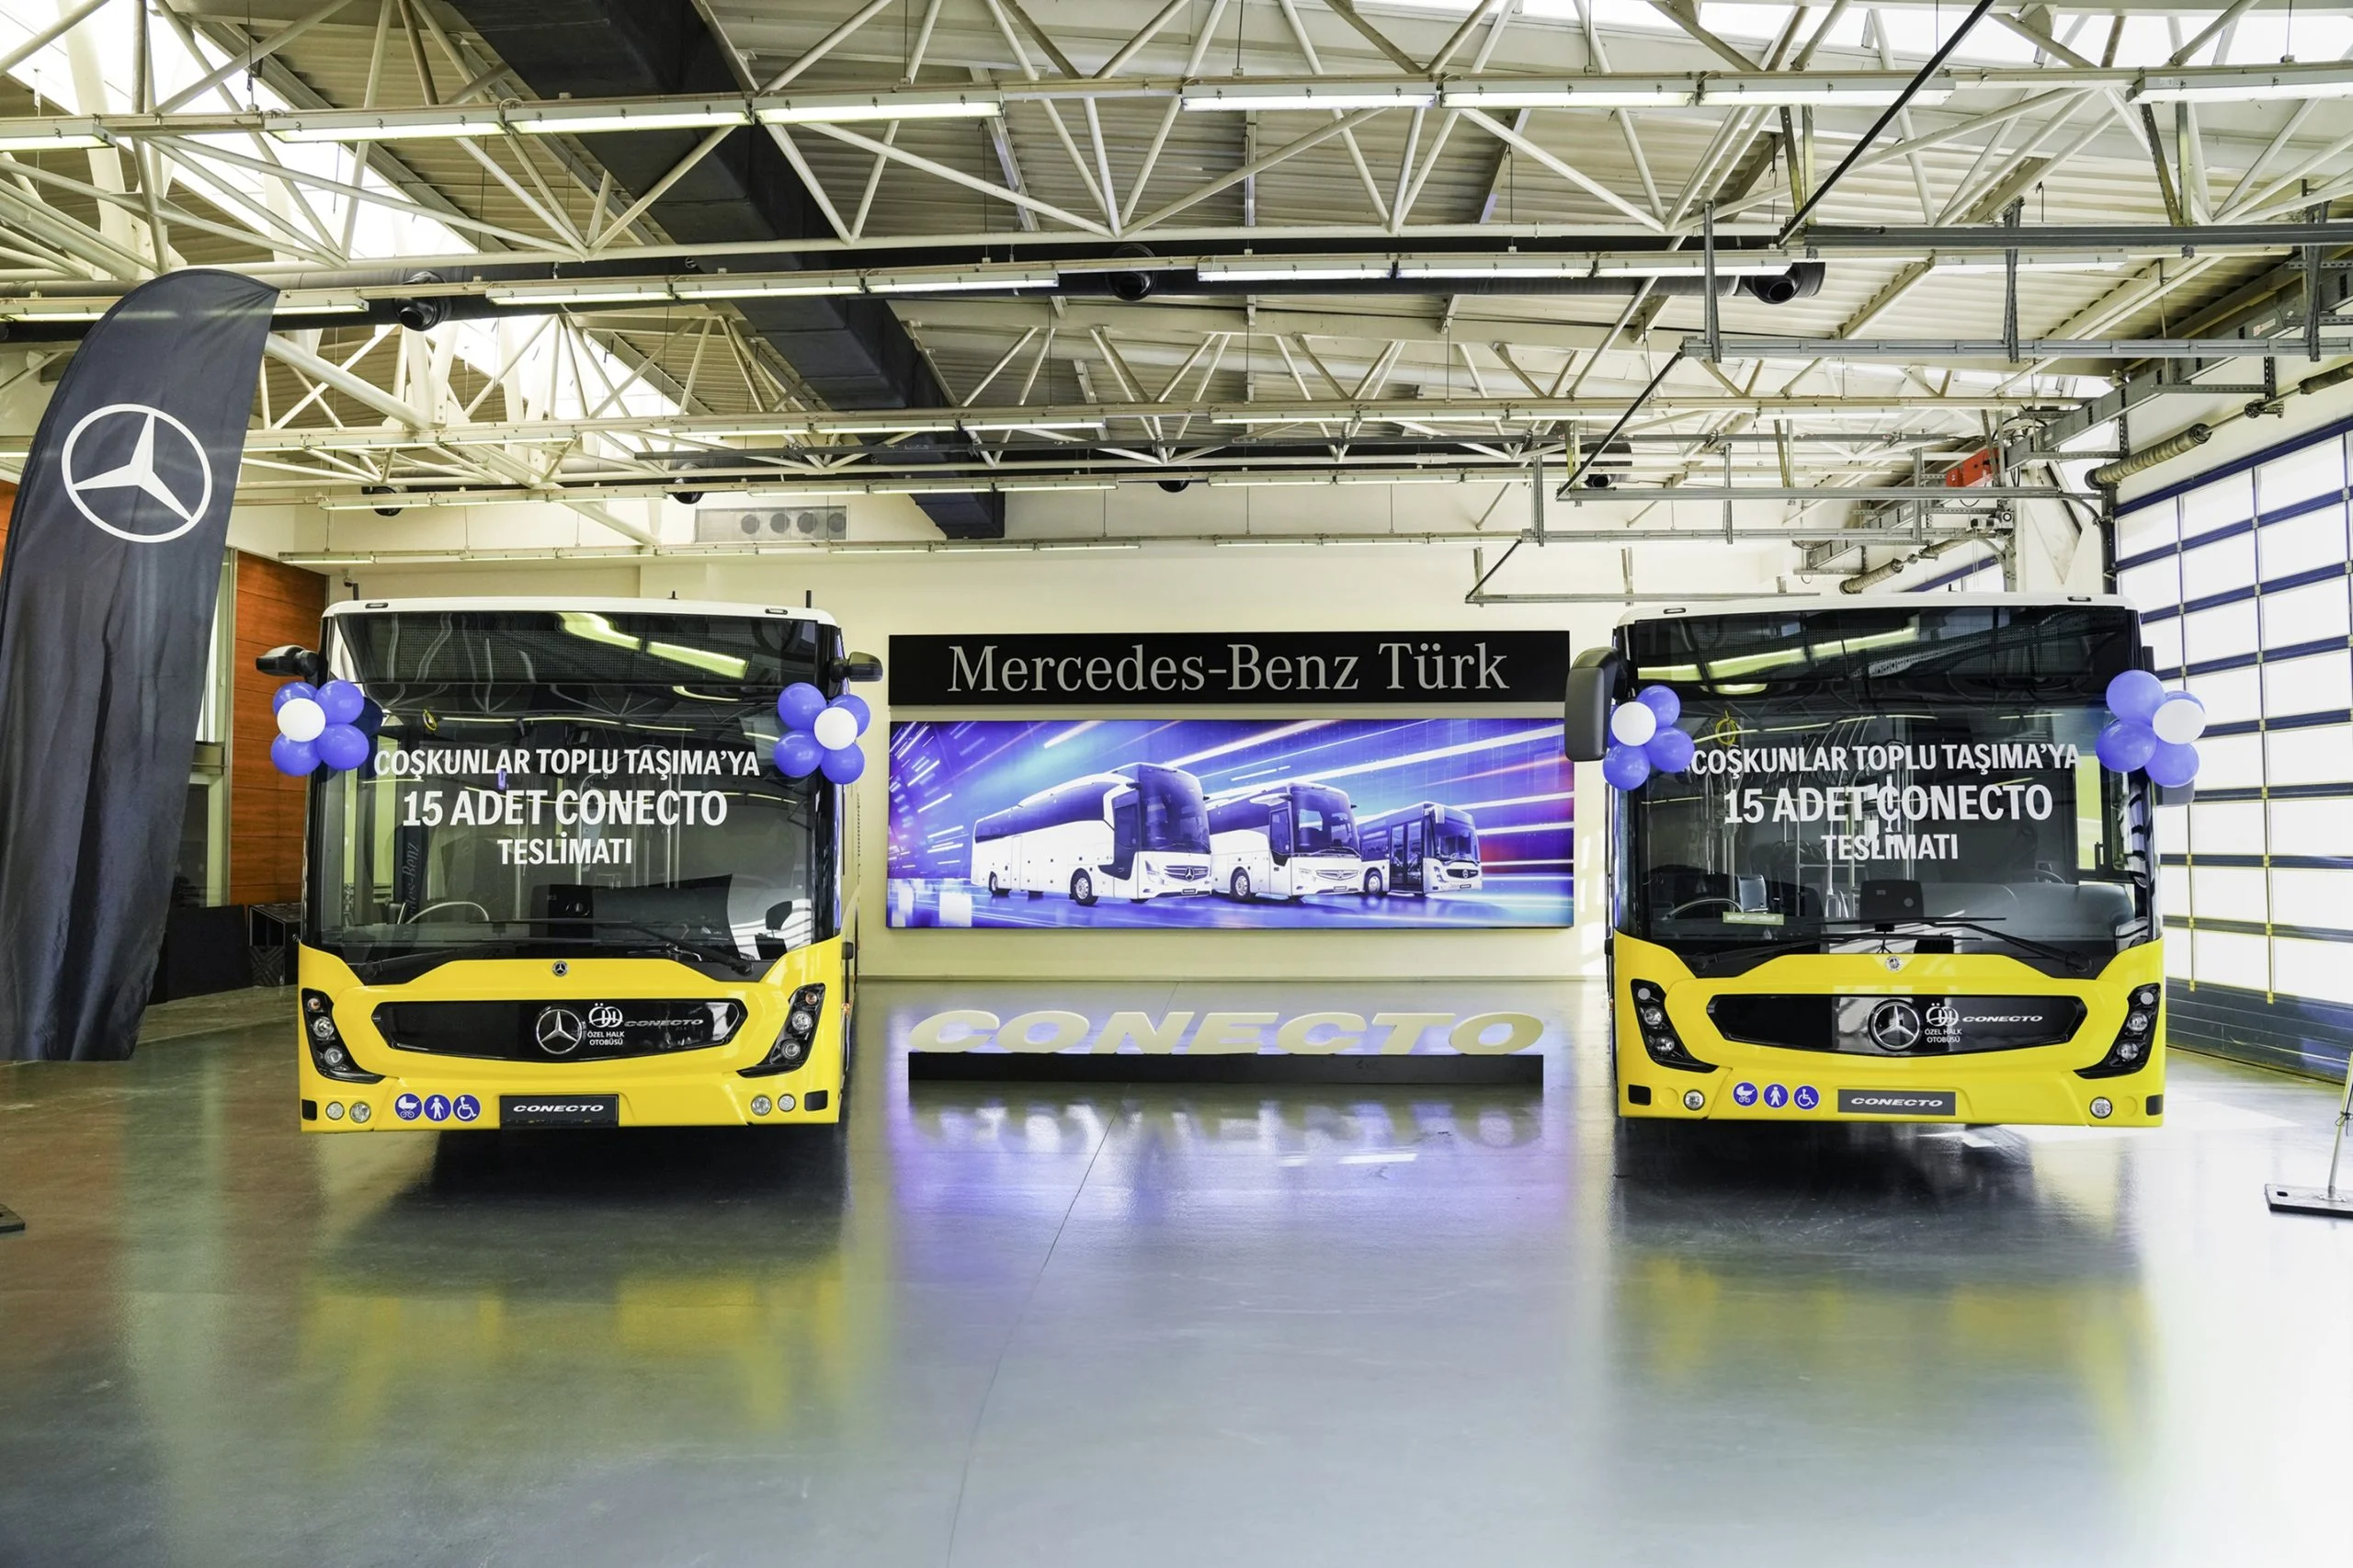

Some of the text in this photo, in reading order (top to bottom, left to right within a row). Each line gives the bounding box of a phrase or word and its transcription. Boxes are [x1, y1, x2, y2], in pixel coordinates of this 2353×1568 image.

[947, 642, 1509, 692] Mercedes-Benz Türk
[374, 749, 760, 780] COŞKUNLAR TOPLU TAŞIMA'YA
[1691, 744, 2083, 780] COŞKUNLAR TOPLU TAŞIMA'YA
[403, 790, 728, 826] 15 ADET CONECTO
[1724, 784, 2052, 824] 15 ADET CONECTO
[497, 831, 632, 865] TESLİMATI
[624, 1018, 704, 1028] CONECTO
[1962, 1015, 2043, 1023] CONECTO
[587, 1029, 625, 1039] ÖZEL HALK
[589, 1038, 623, 1046] OTOBÜSÜ
[908, 1010, 1544, 1055] CONECTO
[1924, 1028, 1962, 1036] ÖZEL HALK
[513, 1105, 605, 1113] CONECTO
[1850, 1096, 1943, 1108] CONECTO
